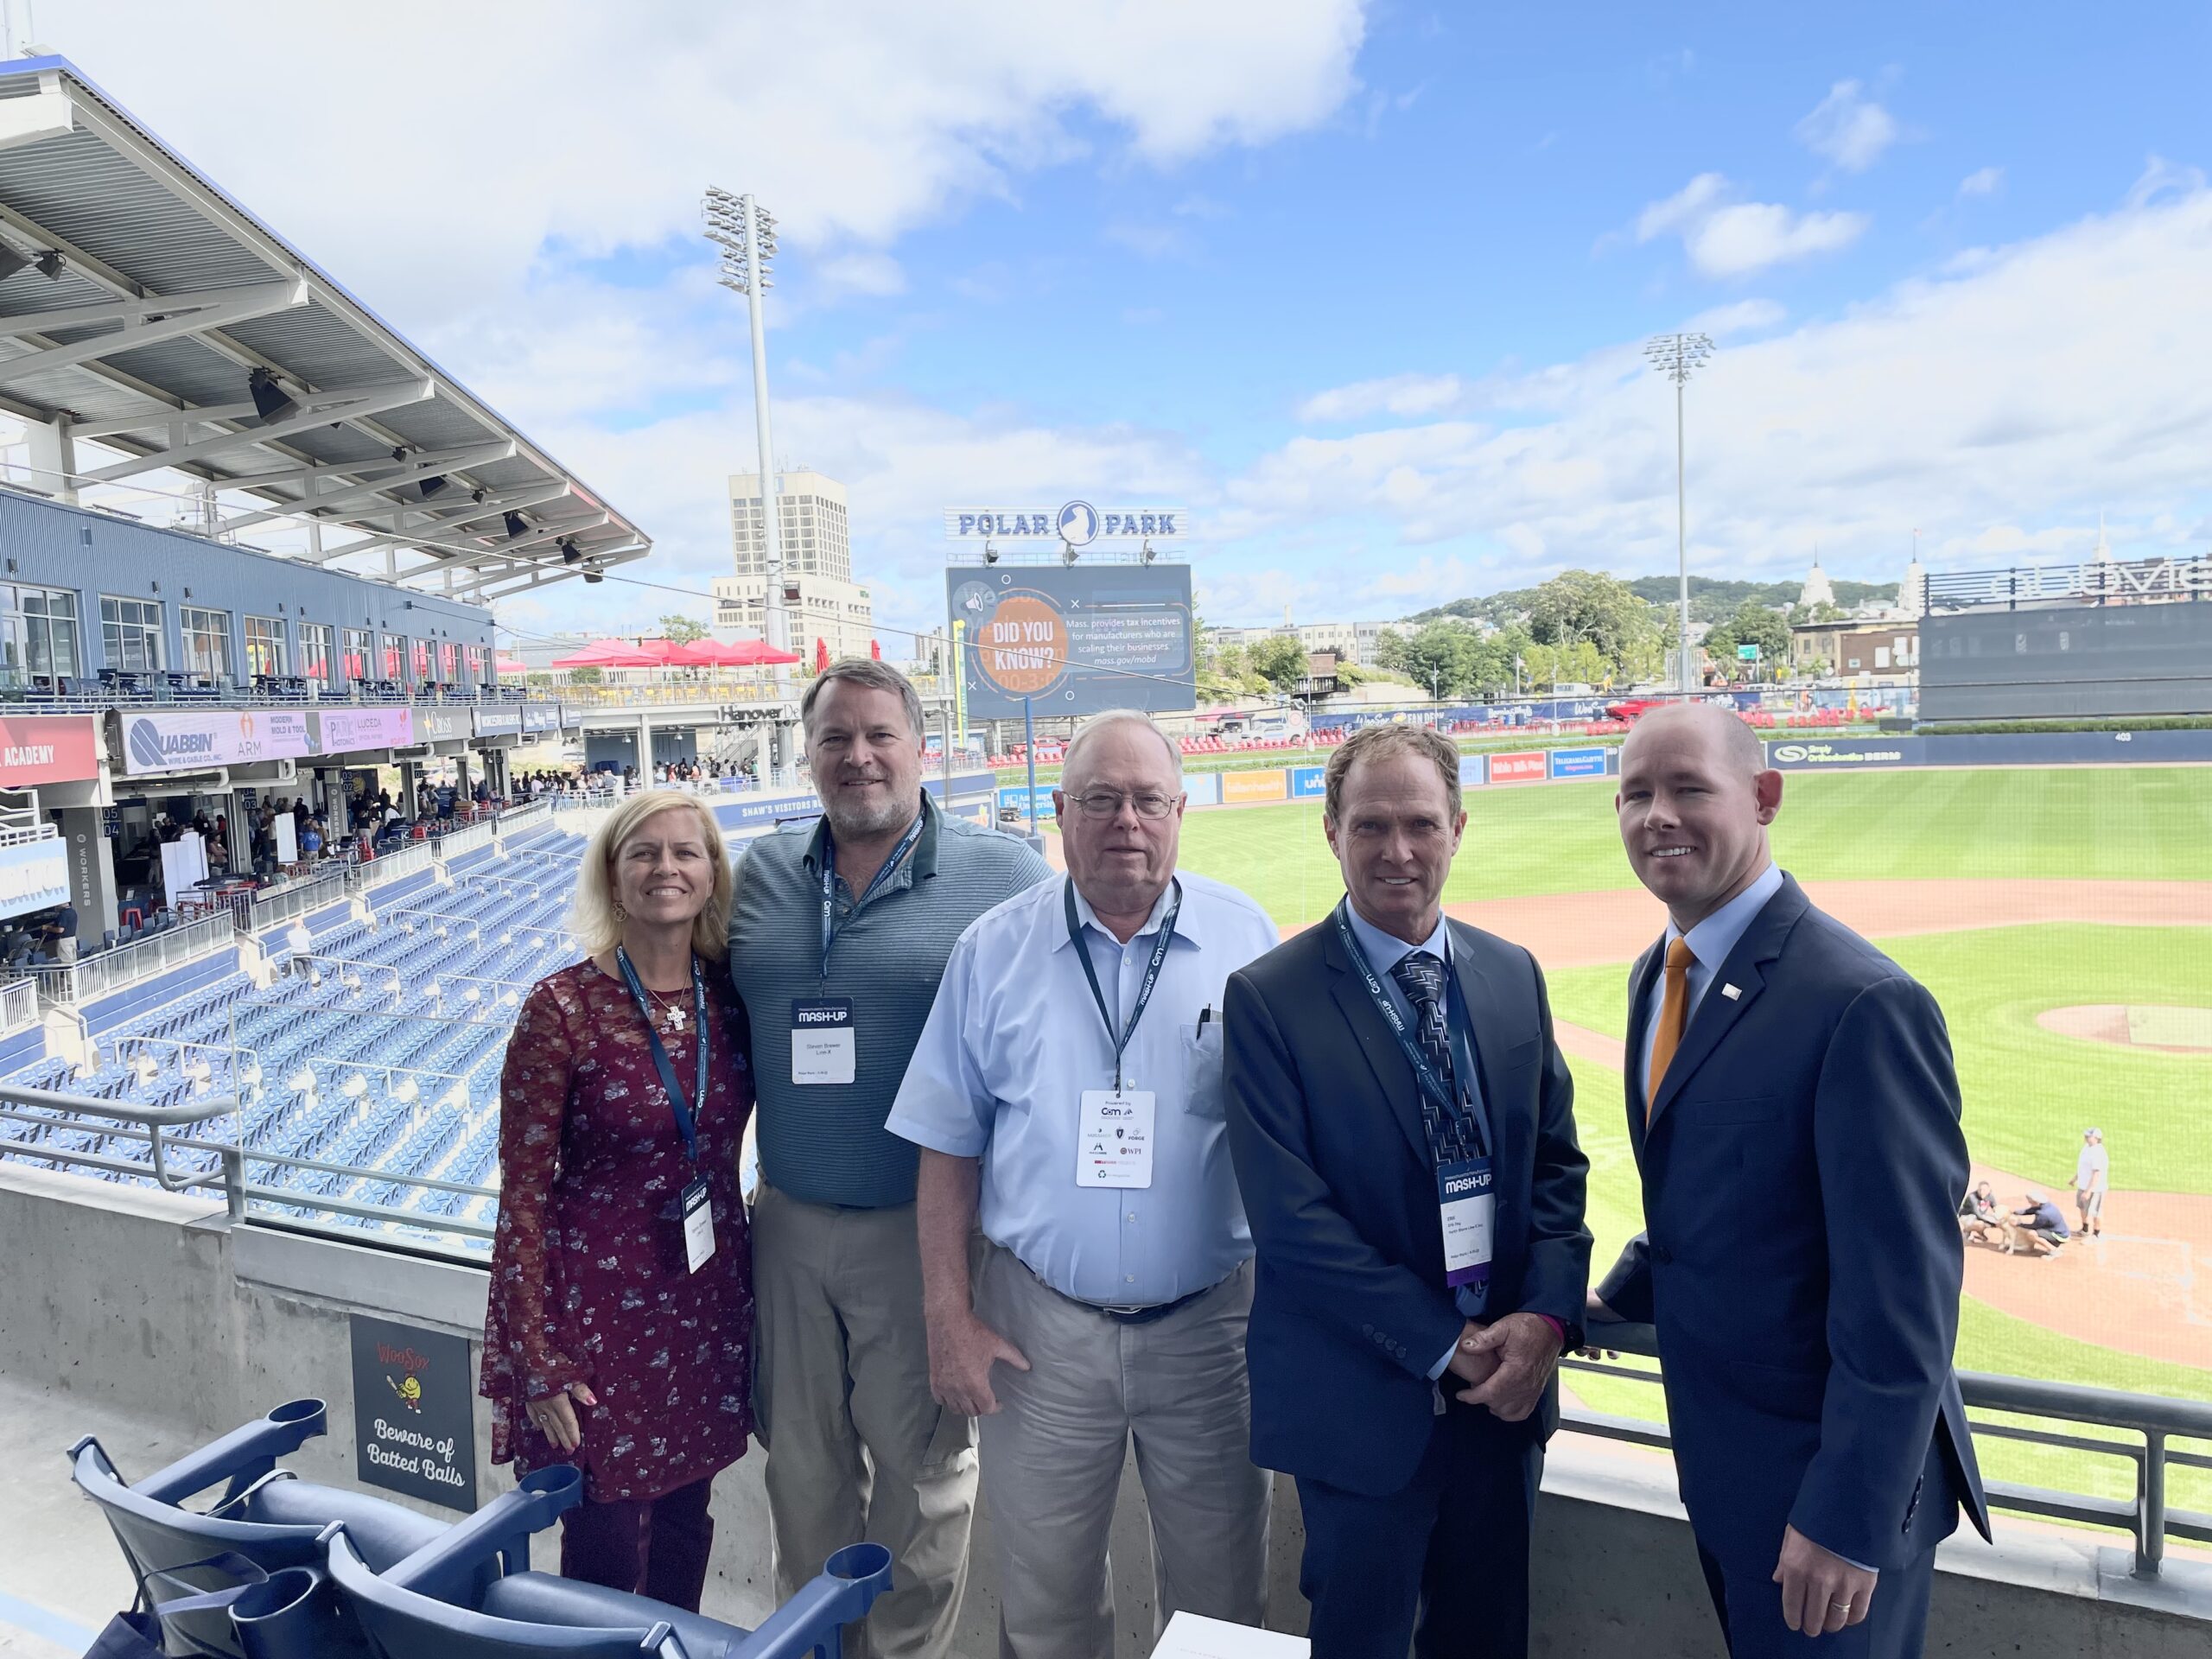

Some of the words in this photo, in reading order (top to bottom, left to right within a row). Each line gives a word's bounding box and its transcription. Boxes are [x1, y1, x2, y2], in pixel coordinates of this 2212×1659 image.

[959, 514, 1050, 534] POLAR
[1105, 514, 1177, 534] PARK
[1066, 620, 1089, 628] Mass.
[1091, 619, 1124, 629] provides
[1141, 617, 1180, 626] incentives
[994, 622, 1020, 643] DID
[1022, 621, 1053, 642] YOU
[1085, 632, 1142, 640] manufacturers
[1078, 645, 1105, 653] scaling
[1106, 644, 1124, 652] their
[995, 647, 1054, 671] KNOW?
[1094, 654, 1157, 666] mass.gov/mobd
[720, 705, 783, 721] Hanover
[784, 704, 800, 719] De
[292, 725, 306, 734] TOOL
[4, 745, 54, 767] ACADEMY
[238, 741, 262, 756] ARM
[1808, 744, 1832, 754] Simply
[1808, 753, 1864, 762] Orthodontics
[343, 783, 353, 791] 02
[245, 800, 257, 810] 03
[741, 804, 773, 817] SHAW'S
[774, 801, 810, 812] VISITORS
[103, 809, 118, 819] 05
[104, 824, 119, 836] 04
[79, 848, 91, 906] WORKERS
[1141, 973, 1154, 1006] MASH-UP
[798, 1011, 848, 1022] MASH-UP
[1382, 1000, 1405, 1032] MASH-UP
[1446, 1174, 1492, 1194] MASH-UP
[685, 1186, 708, 1211] MASH-UP
[376, 1341, 429, 1371] WooSox
[374, 1418, 435, 1451] Beware
[435, 1437, 454, 1463] of
[366, 1443, 420, 1474] Batted
[422, 1459, 466, 1487] Balls
